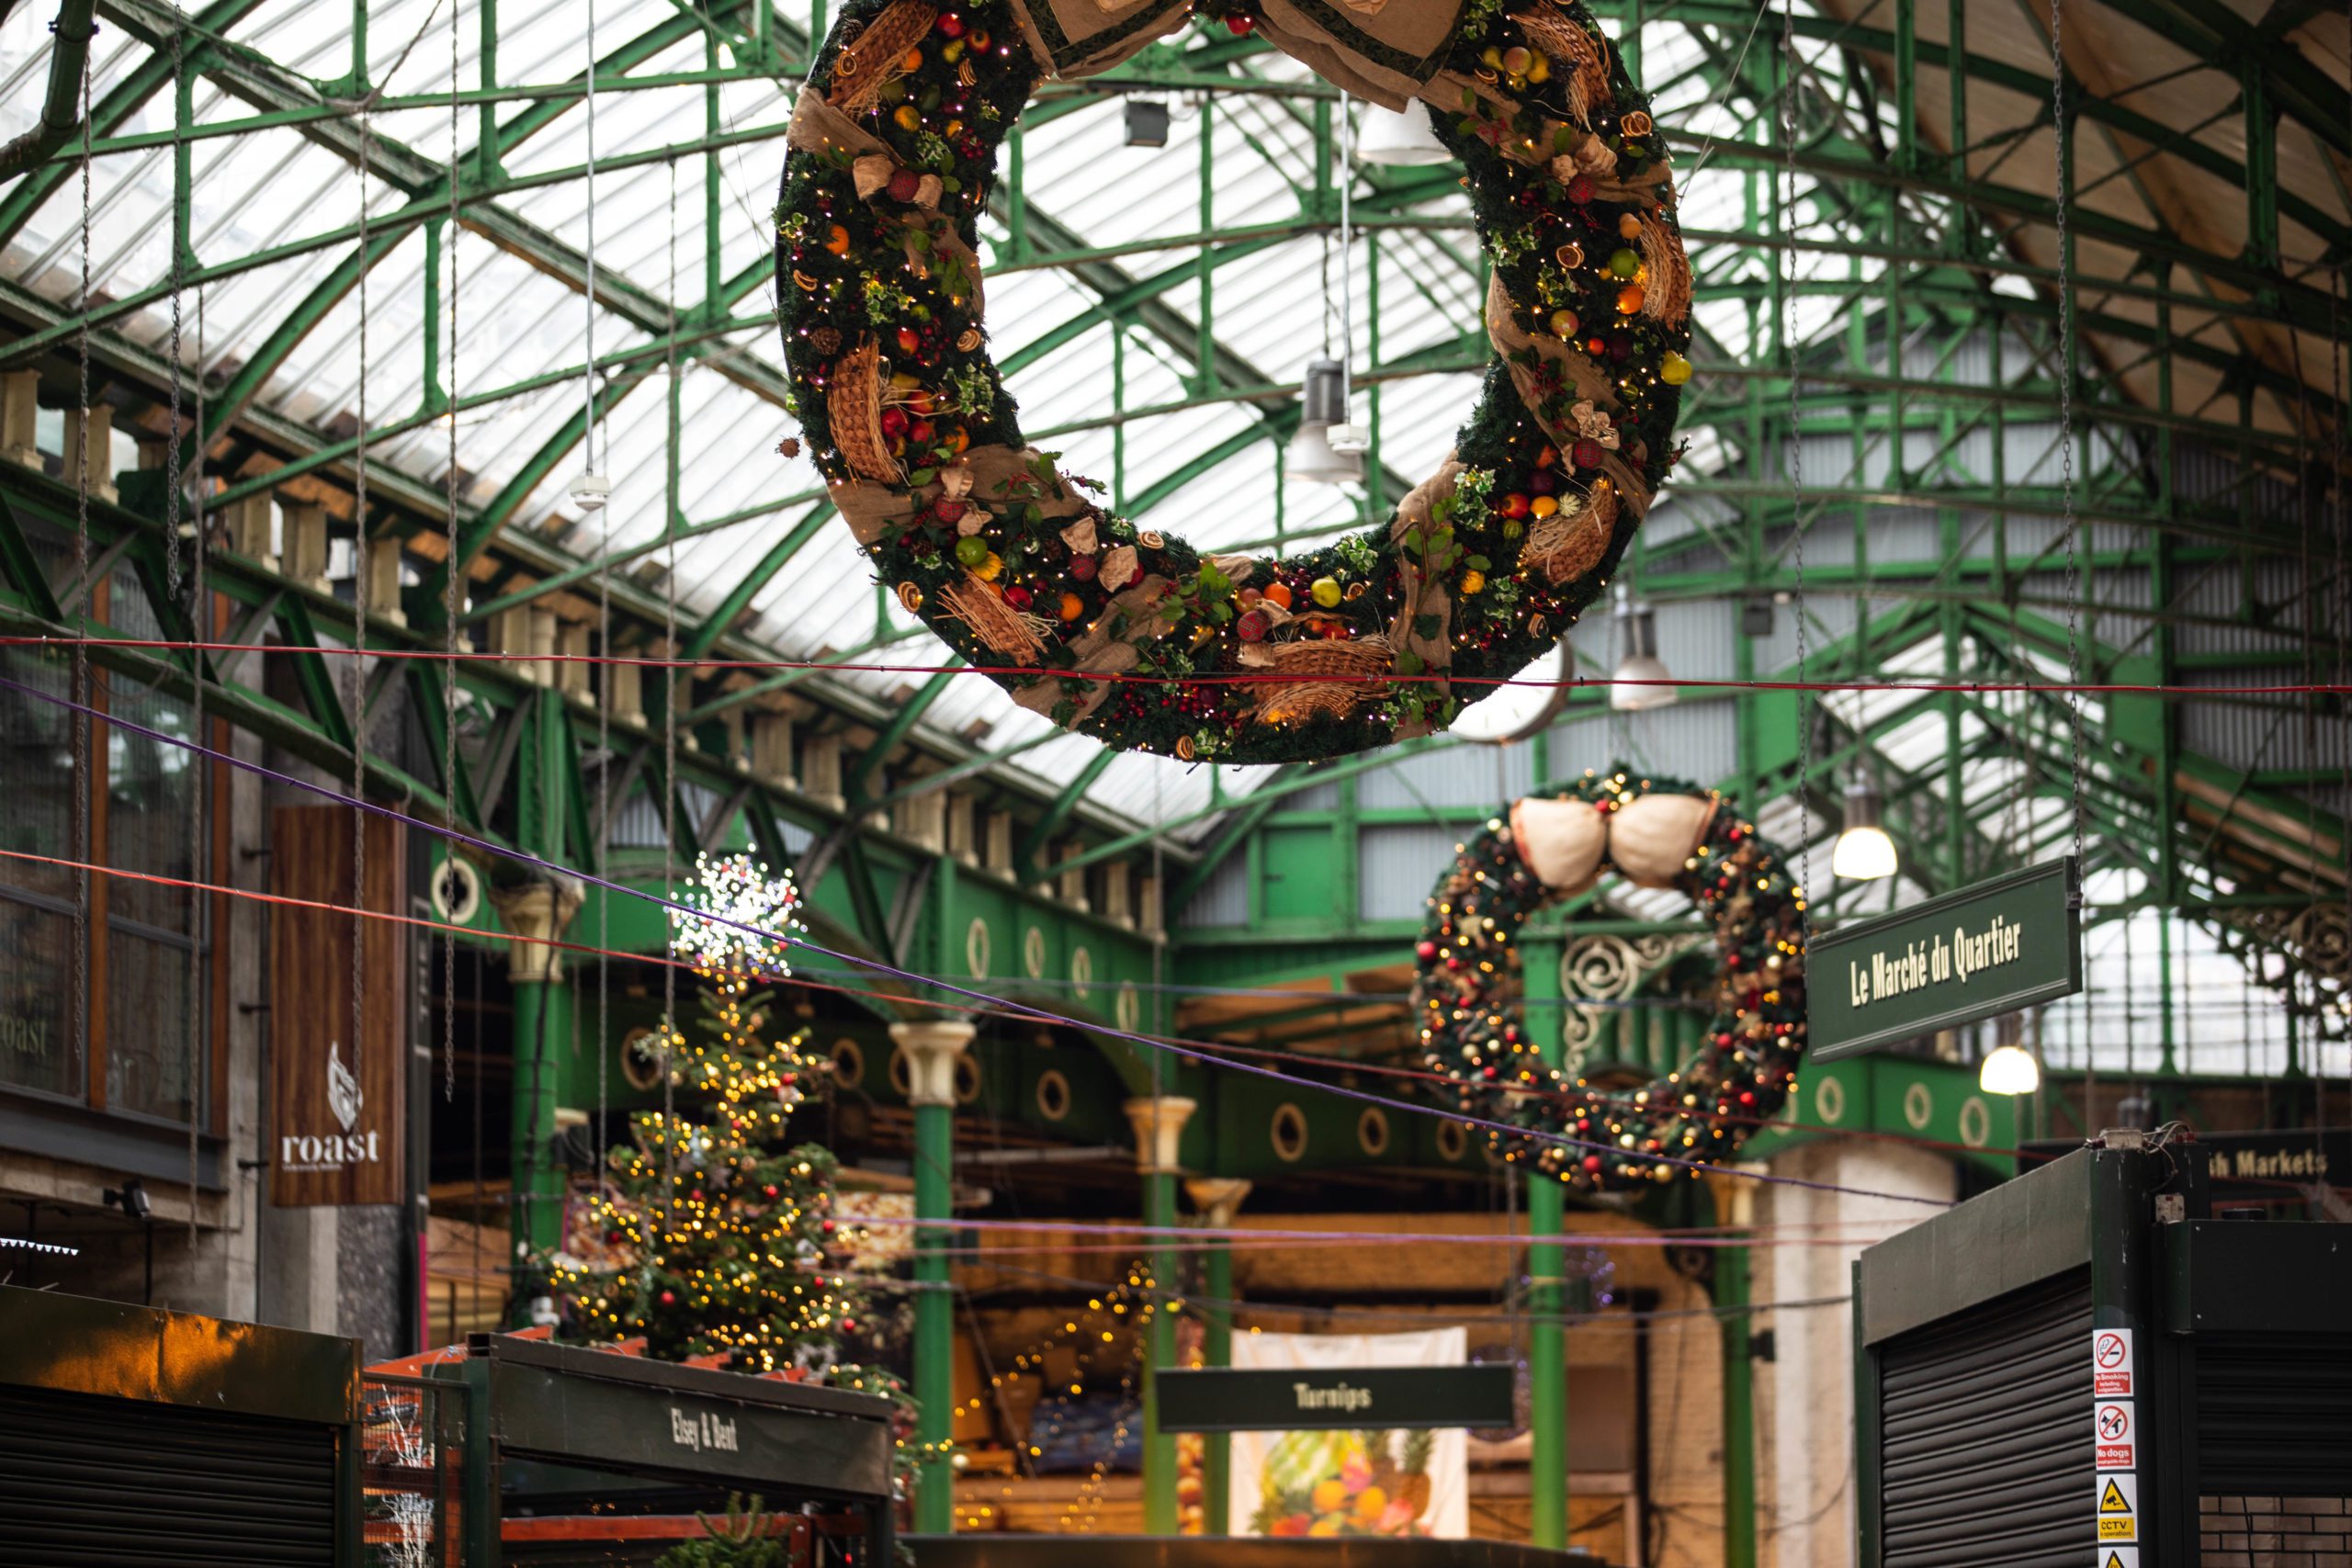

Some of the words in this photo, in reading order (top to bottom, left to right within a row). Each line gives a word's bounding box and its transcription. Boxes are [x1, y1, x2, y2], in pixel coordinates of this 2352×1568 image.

[1850, 960, 1870, 1008] Le
[1872, 940, 1928, 1001] Marché
[1931, 933, 1951, 984] du
[1954, 914, 2021, 984] Quartier
[0, 1015, 48, 1057] oast
[282, 1129, 381, 1164] roast
[2235, 1148, 2328, 1178] Markets
[1294, 1381, 1374, 1413] Turnips
[701, 1411, 712, 1448] &
[2097, 1448, 2107, 1458] No
[2107, 1448, 2130, 1459] dogs
[2101, 1520, 2128, 1530] CCTV
